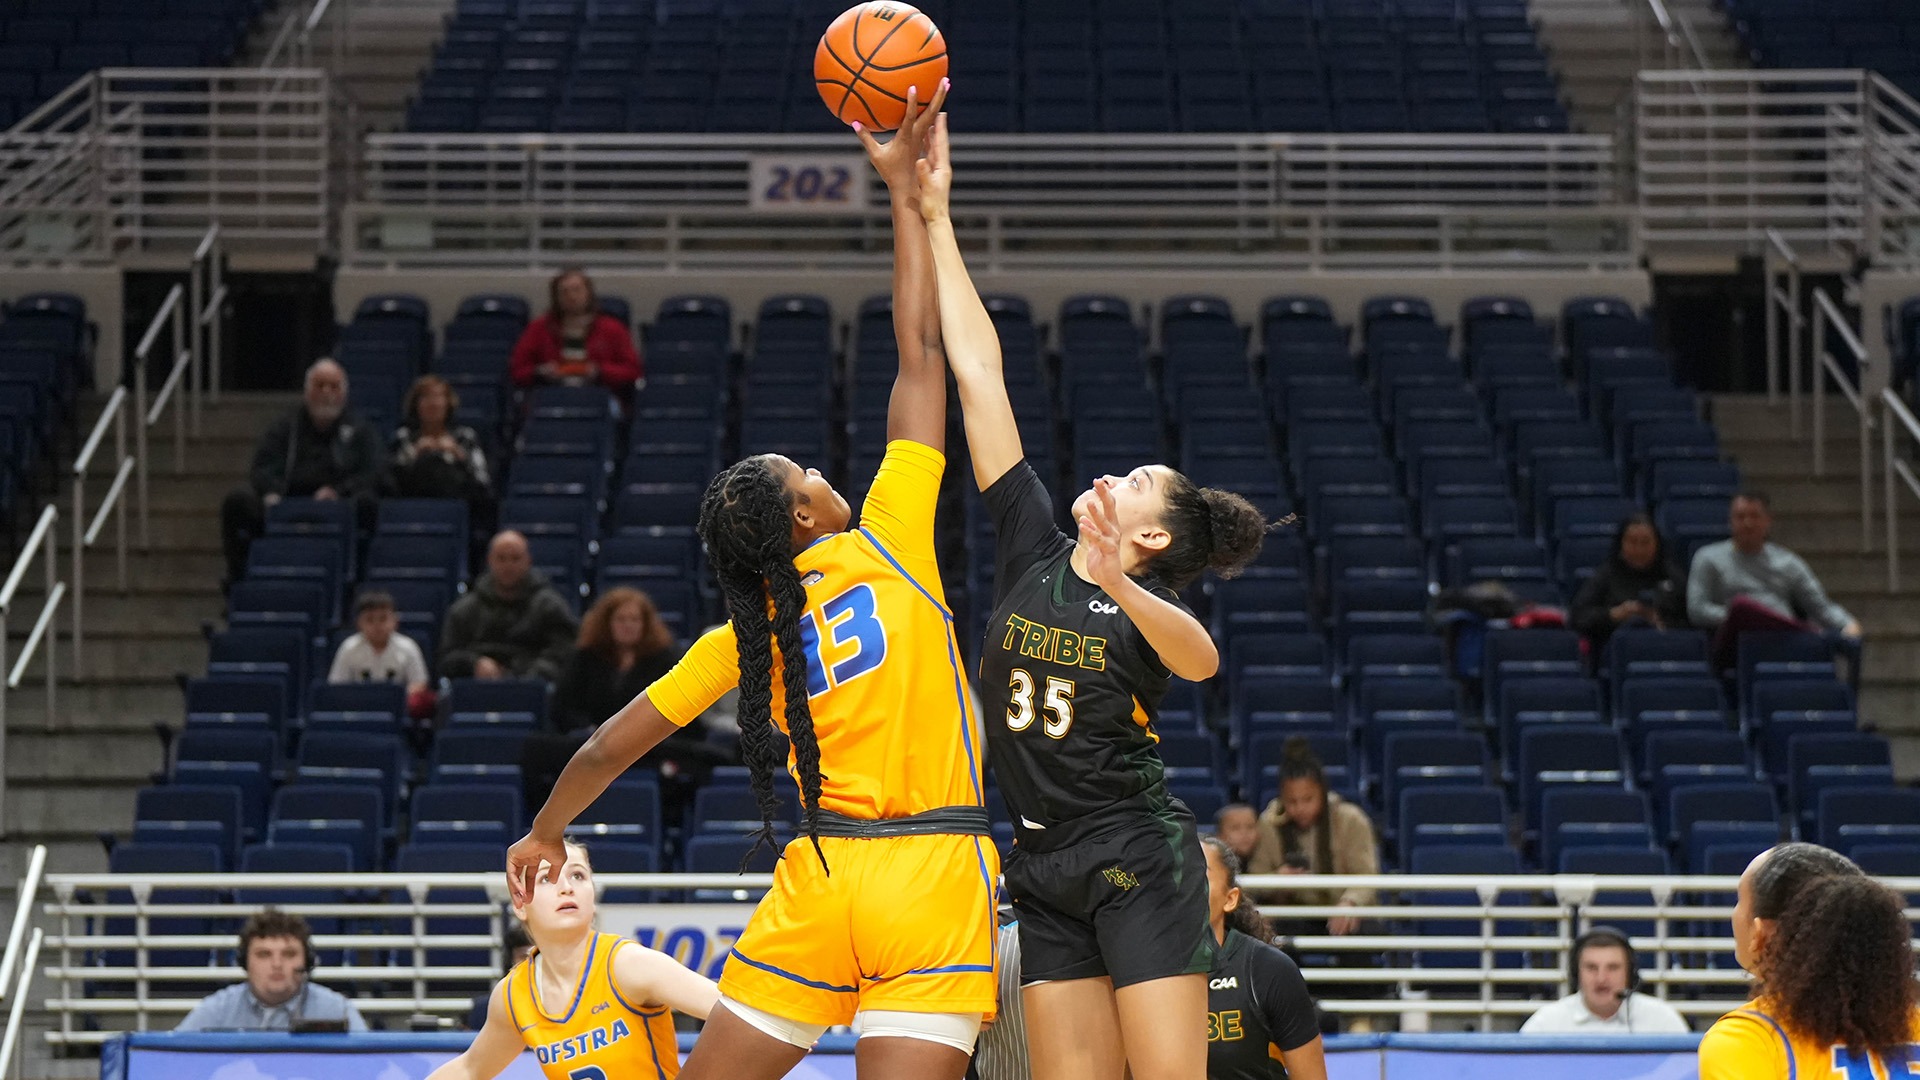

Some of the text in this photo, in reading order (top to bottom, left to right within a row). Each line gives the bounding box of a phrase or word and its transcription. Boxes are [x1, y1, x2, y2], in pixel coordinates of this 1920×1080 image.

[764, 165, 850, 202] 202
[1088, 599, 1119, 615] CAA
[800, 582, 887, 700] 13
[1002, 612, 1107, 672] TRIBE
[1005, 667, 1075, 739] 35
[1209, 976, 1238, 990] CAA
